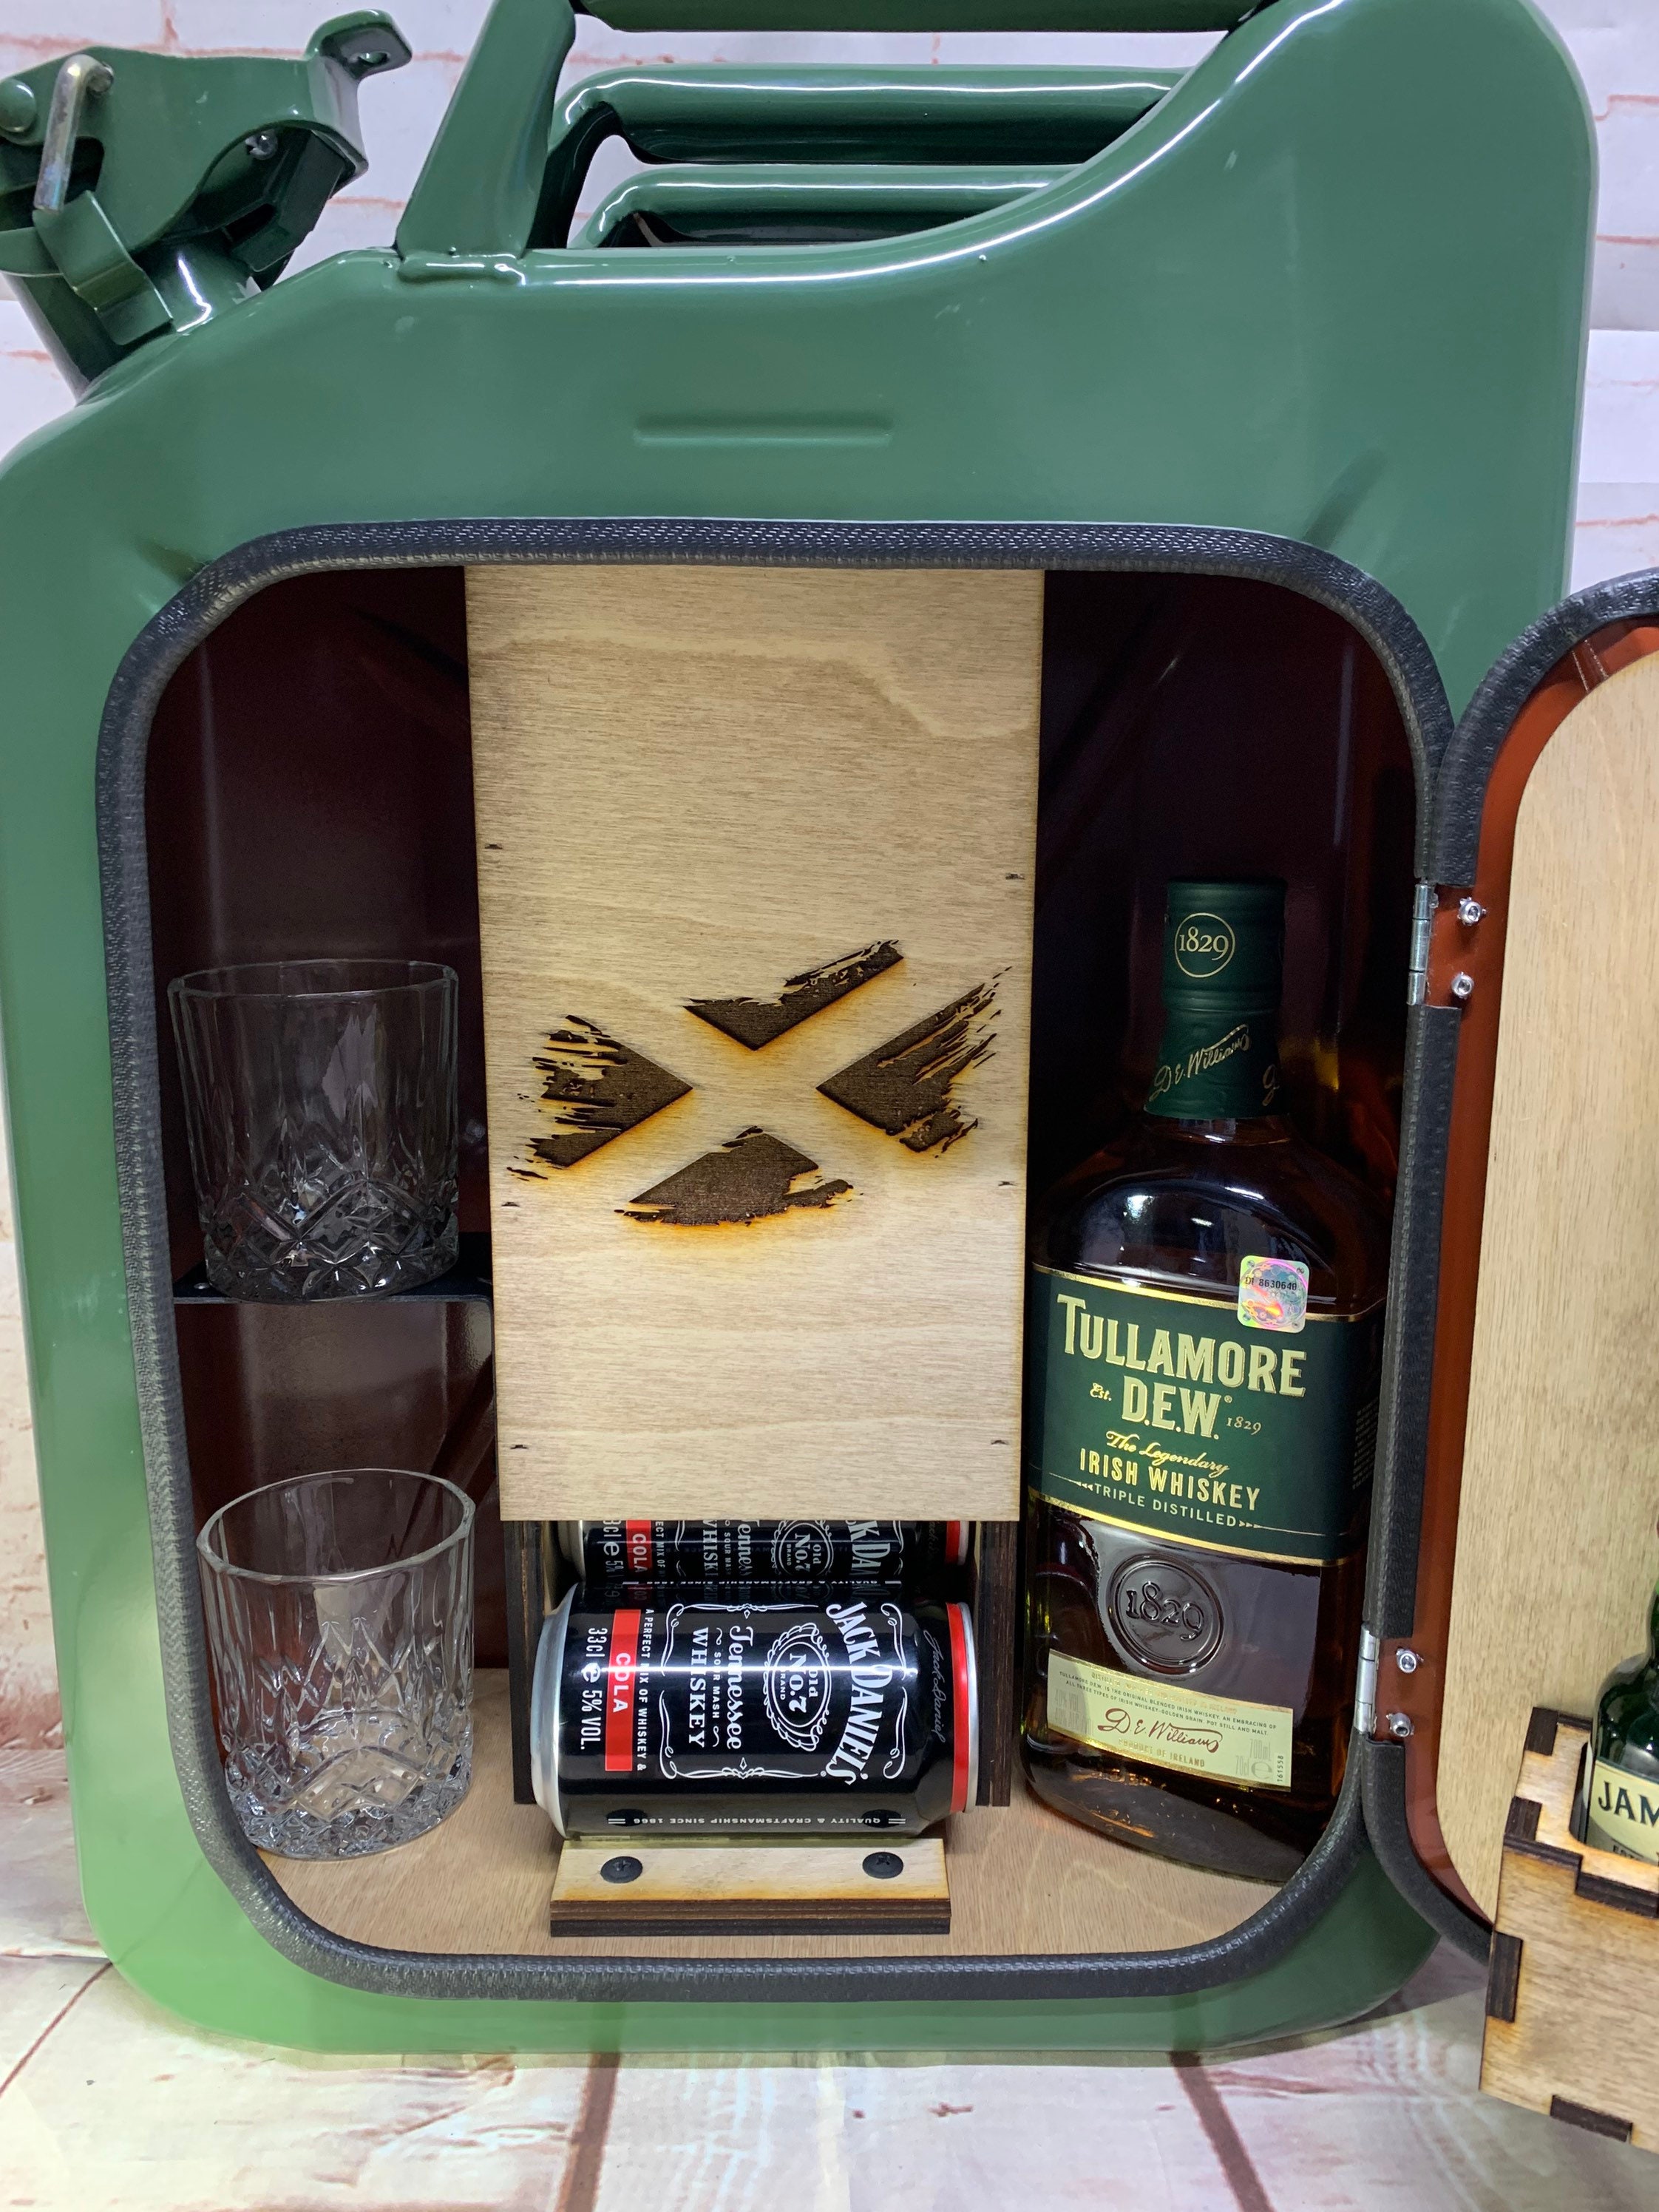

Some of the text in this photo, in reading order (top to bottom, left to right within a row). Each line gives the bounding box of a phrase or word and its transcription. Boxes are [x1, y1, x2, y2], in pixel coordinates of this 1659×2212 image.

[1178, 926, 1229, 961] 1829
[1056, 1293, 1308, 1397] TULLAMORE
[1090, 1382, 1113, 1402] Est.
[1226, 1416, 1262, 1436] 1829
[1106, 1430, 1230, 1478] The Legendary
[1079, 1448, 1261, 1511] IRISH WHISKEY
[1094, 1483, 1237, 1527] TRIPLE DISTILLED
[632, 1533, 648, 1573] COLA
[657, 1541, 665, 1556] MIX
[657, 1559, 665, 1568] OF
[813, 1544, 822, 1565] Old
[1125, 1581, 1204, 1641] 1829
[586, 1627, 608, 1658] 33cl
[640, 1617, 654, 1658] PERFECT
[826, 1601, 881, 1665] JACK
[581, 1689, 603, 1712] 5%
[613, 1652, 631, 1713] COLA
[638, 1689, 649, 1703] OF
[689, 1627, 709, 1748] WHISKEY
[712, 1686, 721, 1719] MASH
[727, 1625, 754, 1750] Tennessee
[1059, 1670, 1089, 1685] TULLAMORE
[1111, 1688, 1122, 1696] THE
[1122, 1691, 1148, 1703] ORIGINAL
[1149, 1698, 1175, 1710] BLENDED
[1176, 1705, 1192, 1714] IRISH
[1232, 1717, 1268, 1728] EMBRACING
[1065, 1680, 1076, 1688] ALL
[1076, 1683, 1092, 1693] THREE
[1093, 1689, 1109, 1699] TYPES
[1118, 1697, 1133, 1706] IRISH
[1220, 1723, 1236, 1731] STILL
[580, 1717, 602, 1751] VOL.
[637, 1708, 648, 1760] WHISKEY
[1156, 1748, 1167, 1758] OF
[1170, 1751, 1206, 1768] IRELAND
